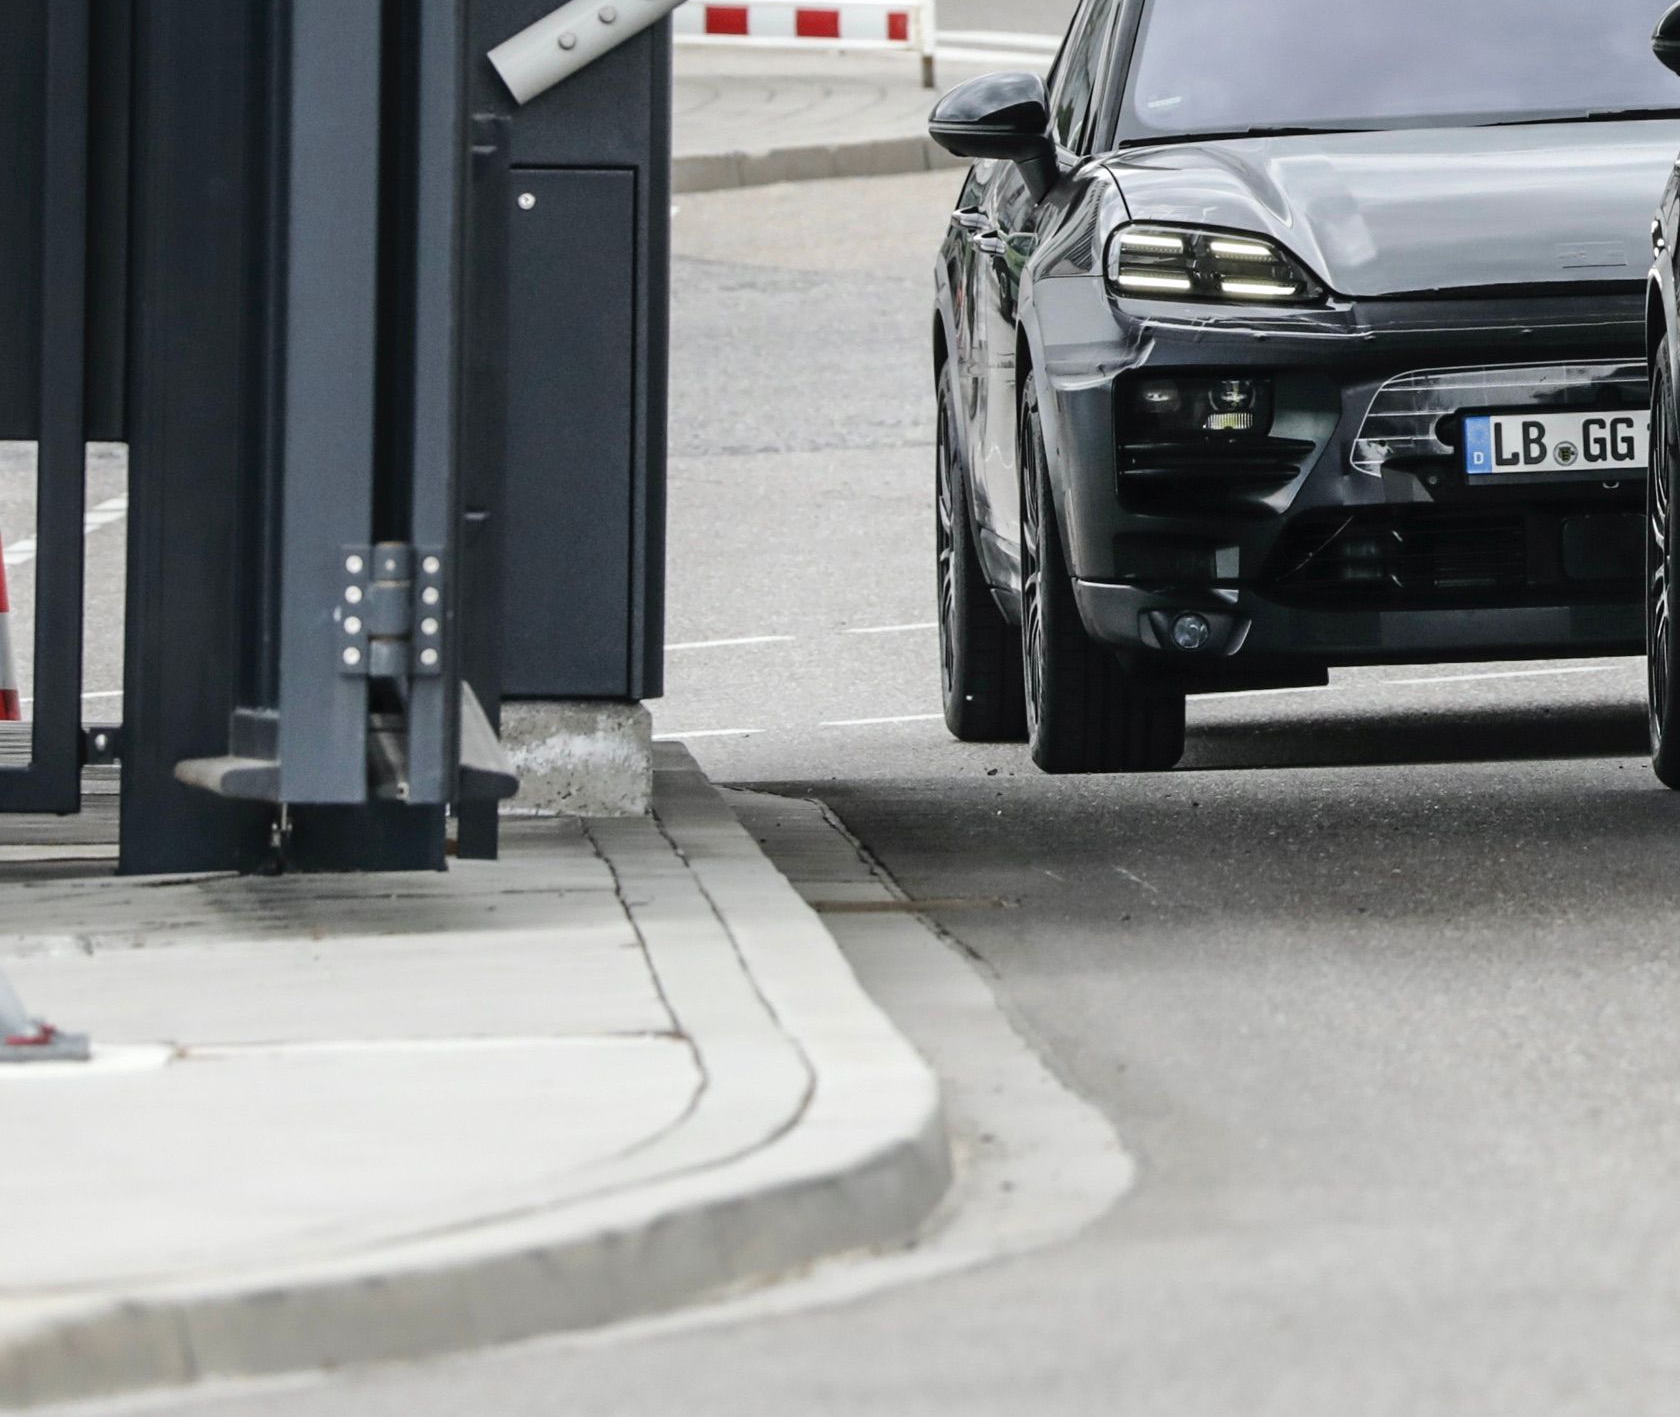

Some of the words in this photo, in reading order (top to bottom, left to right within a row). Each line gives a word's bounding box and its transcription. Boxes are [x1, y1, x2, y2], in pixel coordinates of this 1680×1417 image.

[1494, 420, 1548, 466] LB
[1582, 416, 1635, 463] GG
[1473, 451, 1484, 465] D
